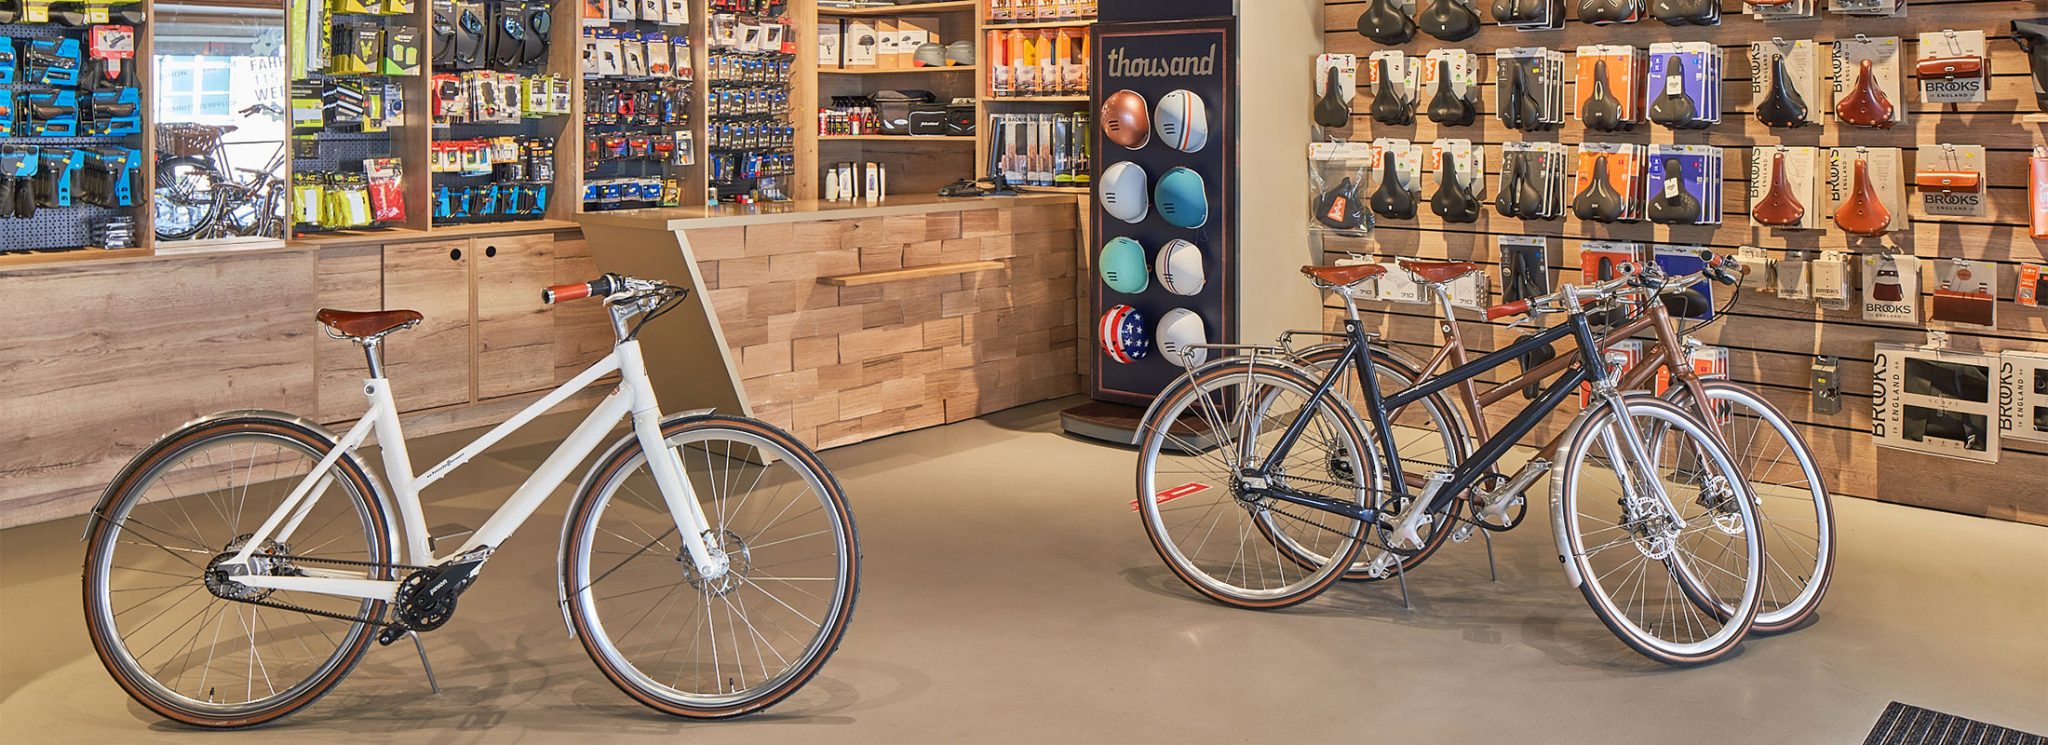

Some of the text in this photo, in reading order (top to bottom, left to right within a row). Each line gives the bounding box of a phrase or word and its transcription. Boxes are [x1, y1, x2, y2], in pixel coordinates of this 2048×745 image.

[1108, 43, 1216, 77] thousand
[1752, 43, 1761, 93] BROOKS
[1833, 40, 1843, 92] BROOKS
[1926, 81, 1980, 92] BROOKS
[1750, 147, 1761, 198] BROOKS
[1830, 149, 1840, 201] BROOKS
[1925, 194, 1979, 206] BROOKS
[1866, 303, 1912, 314] BROOKS
[1872, 353, 1888, 438] BROOKS
[1892, 374, 1900, 422] ENGLAND
[2000, 362, 2013, 431] BROOKS
